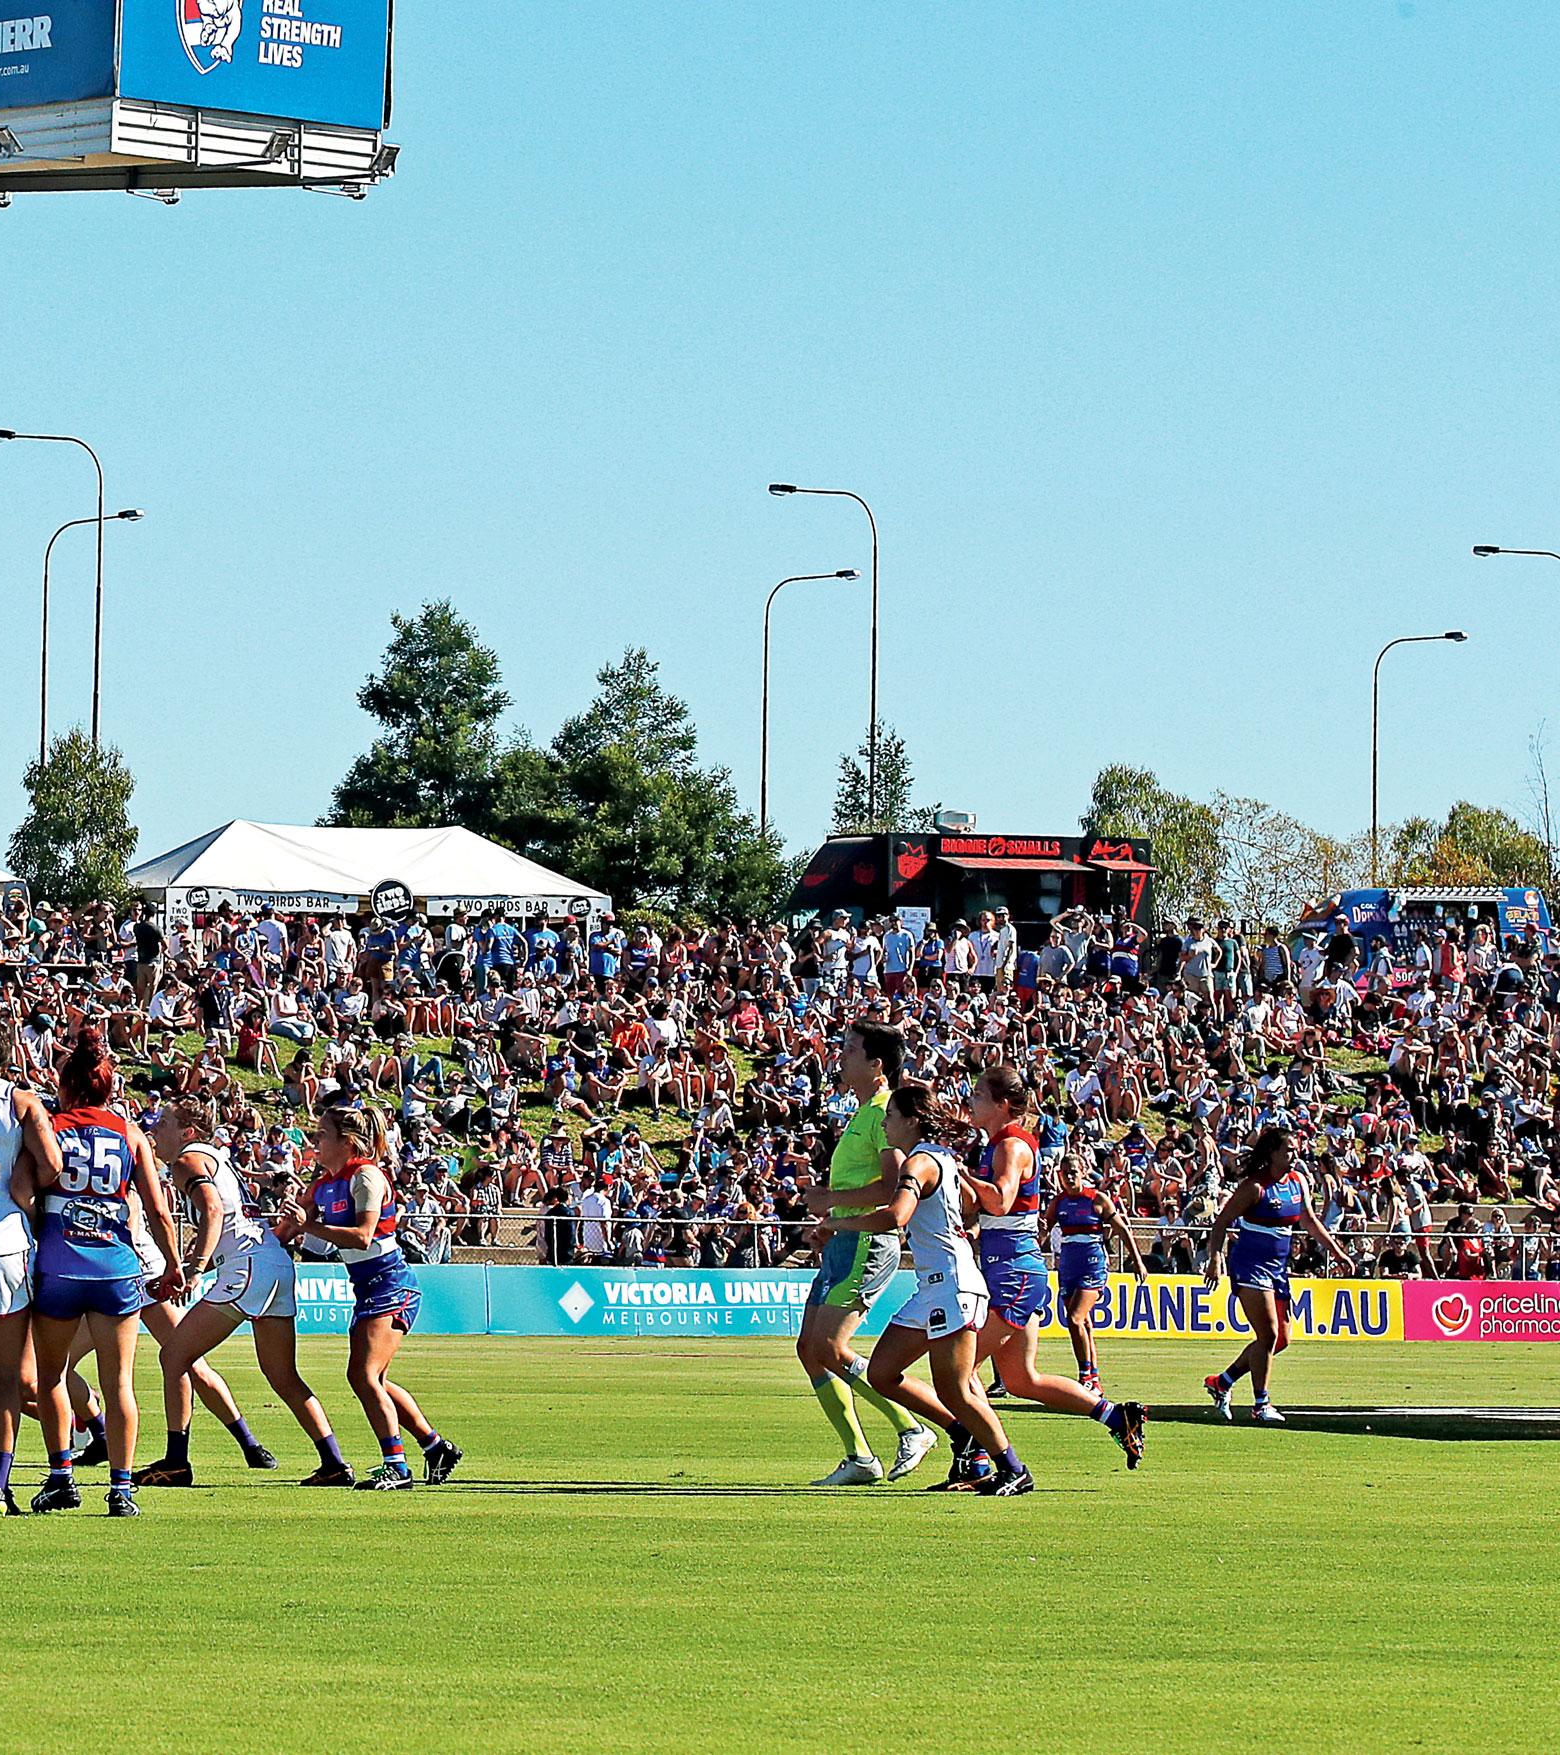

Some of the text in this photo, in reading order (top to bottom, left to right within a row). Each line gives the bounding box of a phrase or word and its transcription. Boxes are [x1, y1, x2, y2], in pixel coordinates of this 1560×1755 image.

[260, 16, 342, 48] STRENGTH
[258, 41, 303, 68] LIVES
[941, 838, 1060, 856] BIGGIE SMALLS
[236, 894, 330, 908] TWO BIRDS BAR
[456, 900, 548, 913] TWO BIRDS BAR
[59, 1136, 122, 1195] 35
[603, 1281, 717, 1305] VICTORIA
[1480, 1293, 1560, 1318] pricelin
[602, 1311, 733, 1325] MELBOURNE
